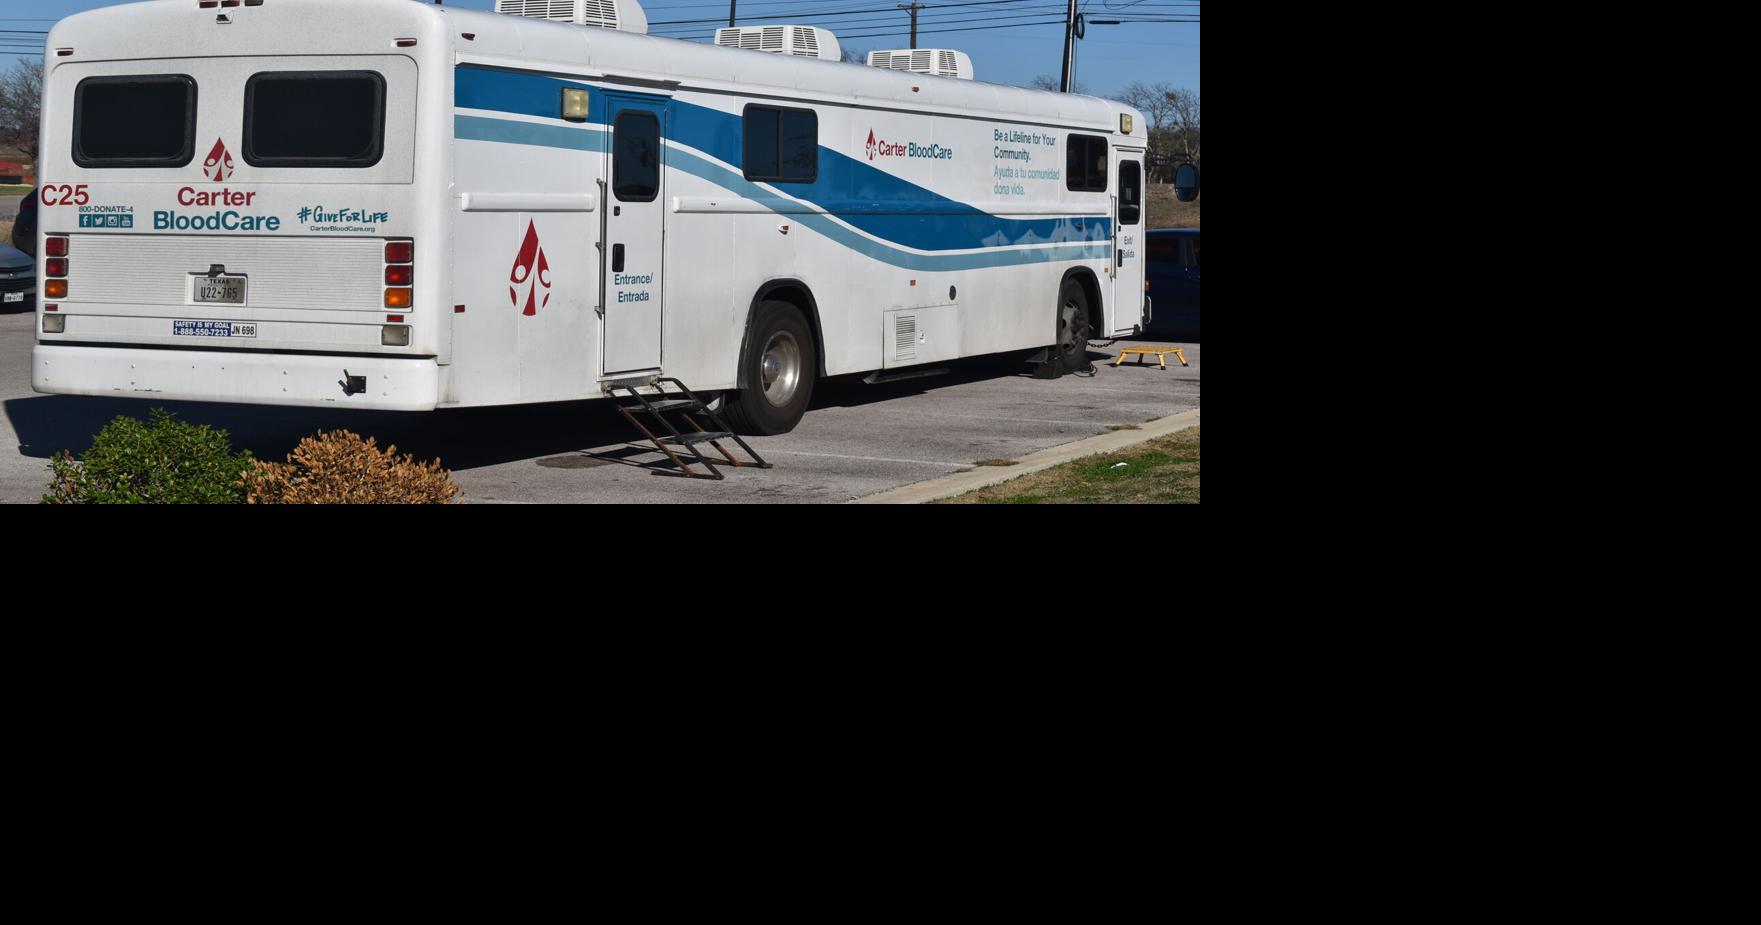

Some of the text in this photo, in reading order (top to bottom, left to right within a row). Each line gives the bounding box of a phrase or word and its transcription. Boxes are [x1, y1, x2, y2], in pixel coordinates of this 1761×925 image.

[994, 129, 1056, 146] Be a Lifeline for Your
[878, 140, 952, 159] Carter BloodCare
[994, 145, 1031, 163] Community.
[994, 165, 1060, 180] Ayuda a tu comunidad
[41, 184, 89, 206] C25
[177, 186, 256, 206] Carter
[994, 182, 1025, 195] dona vida.
[153, 210, 281, 231] BloodCare
[614, 272, 653, 285] Entrance/
[618, 290, 649, 303] Entrada
[174, 328, 228, 336] 1-888-550-7233
[232, 325, 255, 335] JN 698
